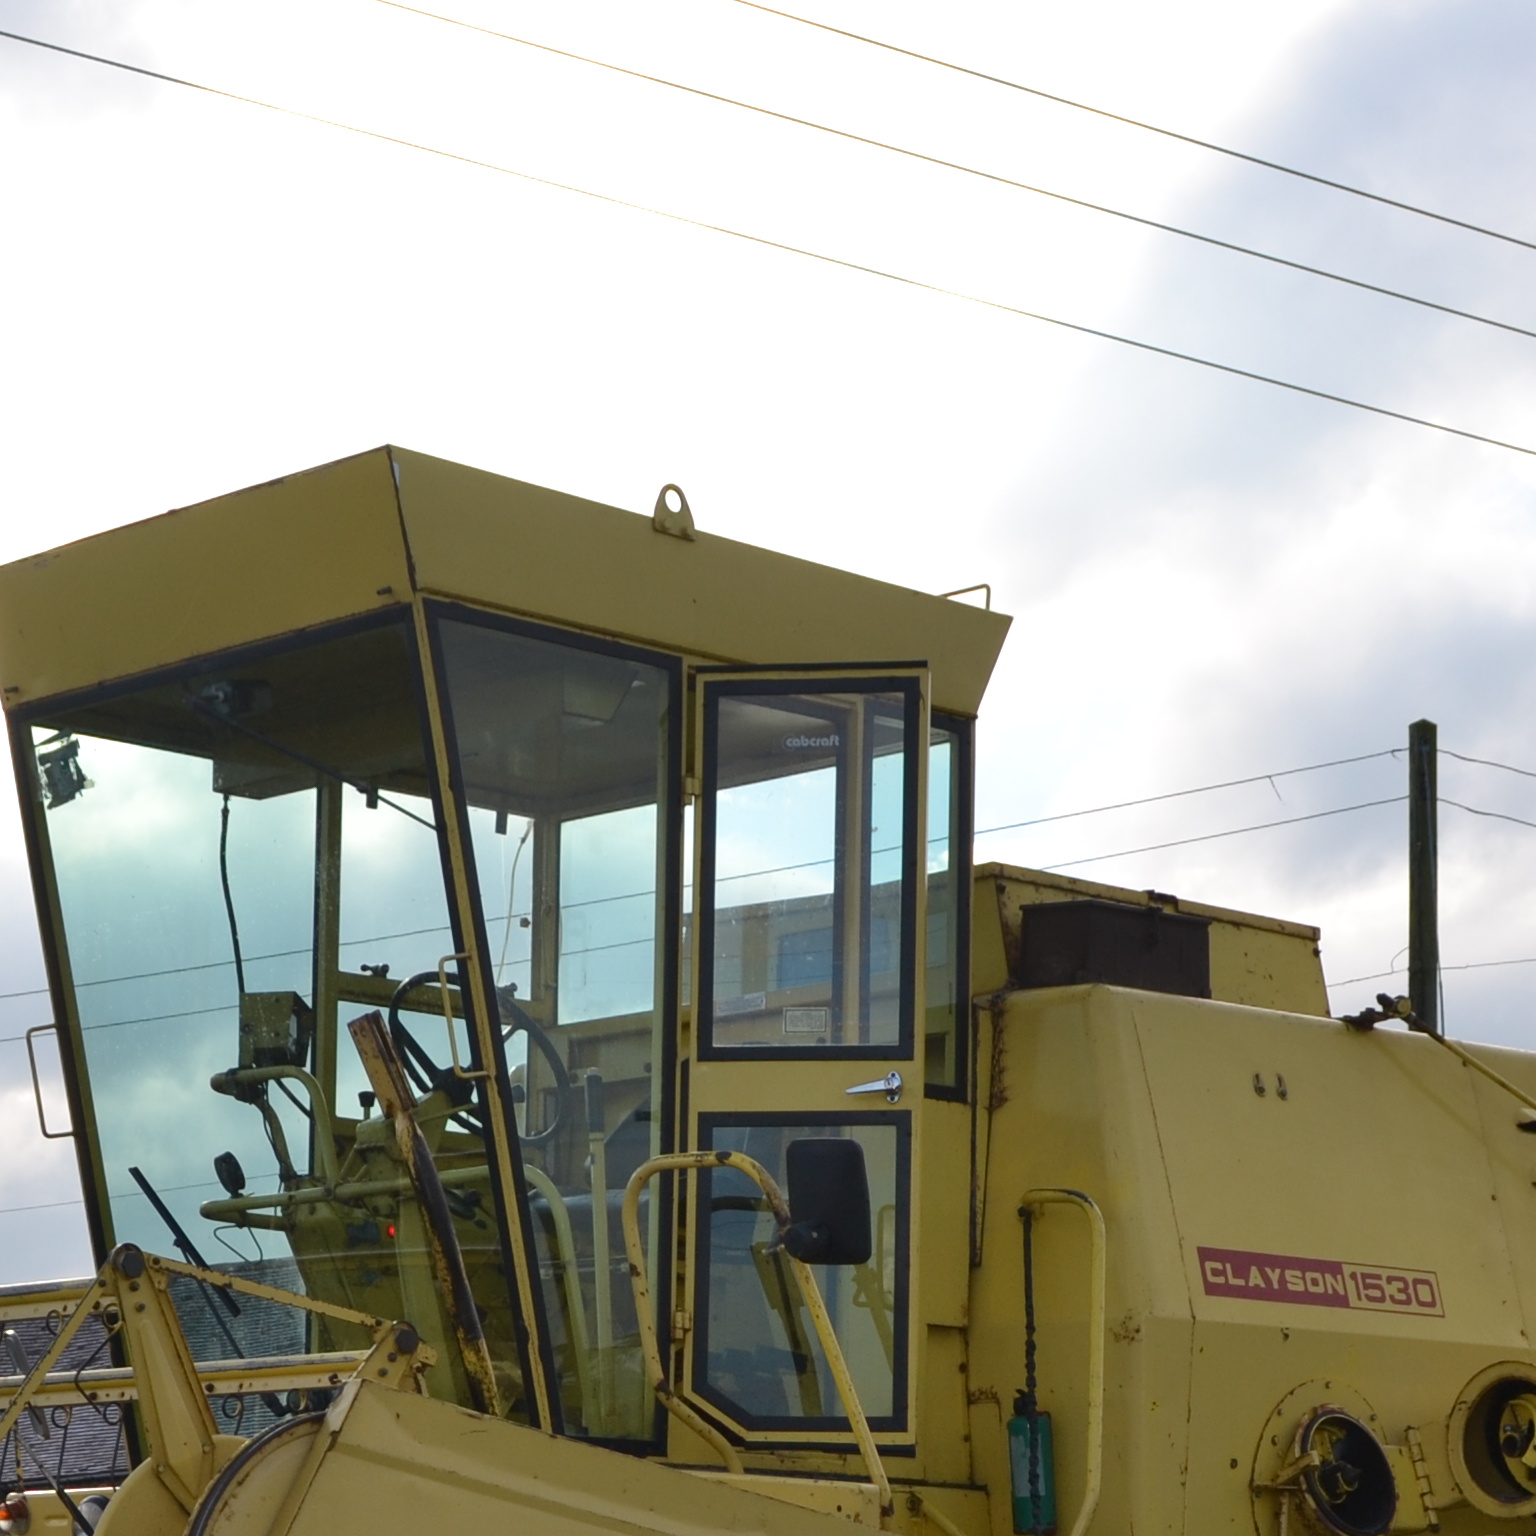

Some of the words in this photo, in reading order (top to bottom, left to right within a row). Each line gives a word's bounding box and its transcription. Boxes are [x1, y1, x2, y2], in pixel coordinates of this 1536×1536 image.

[785, 734, 840, 748] cabcraft
[1204, 1261, 1345, 1296] CLAYSON
[1349, 1271, 1437, 1309] 1530
